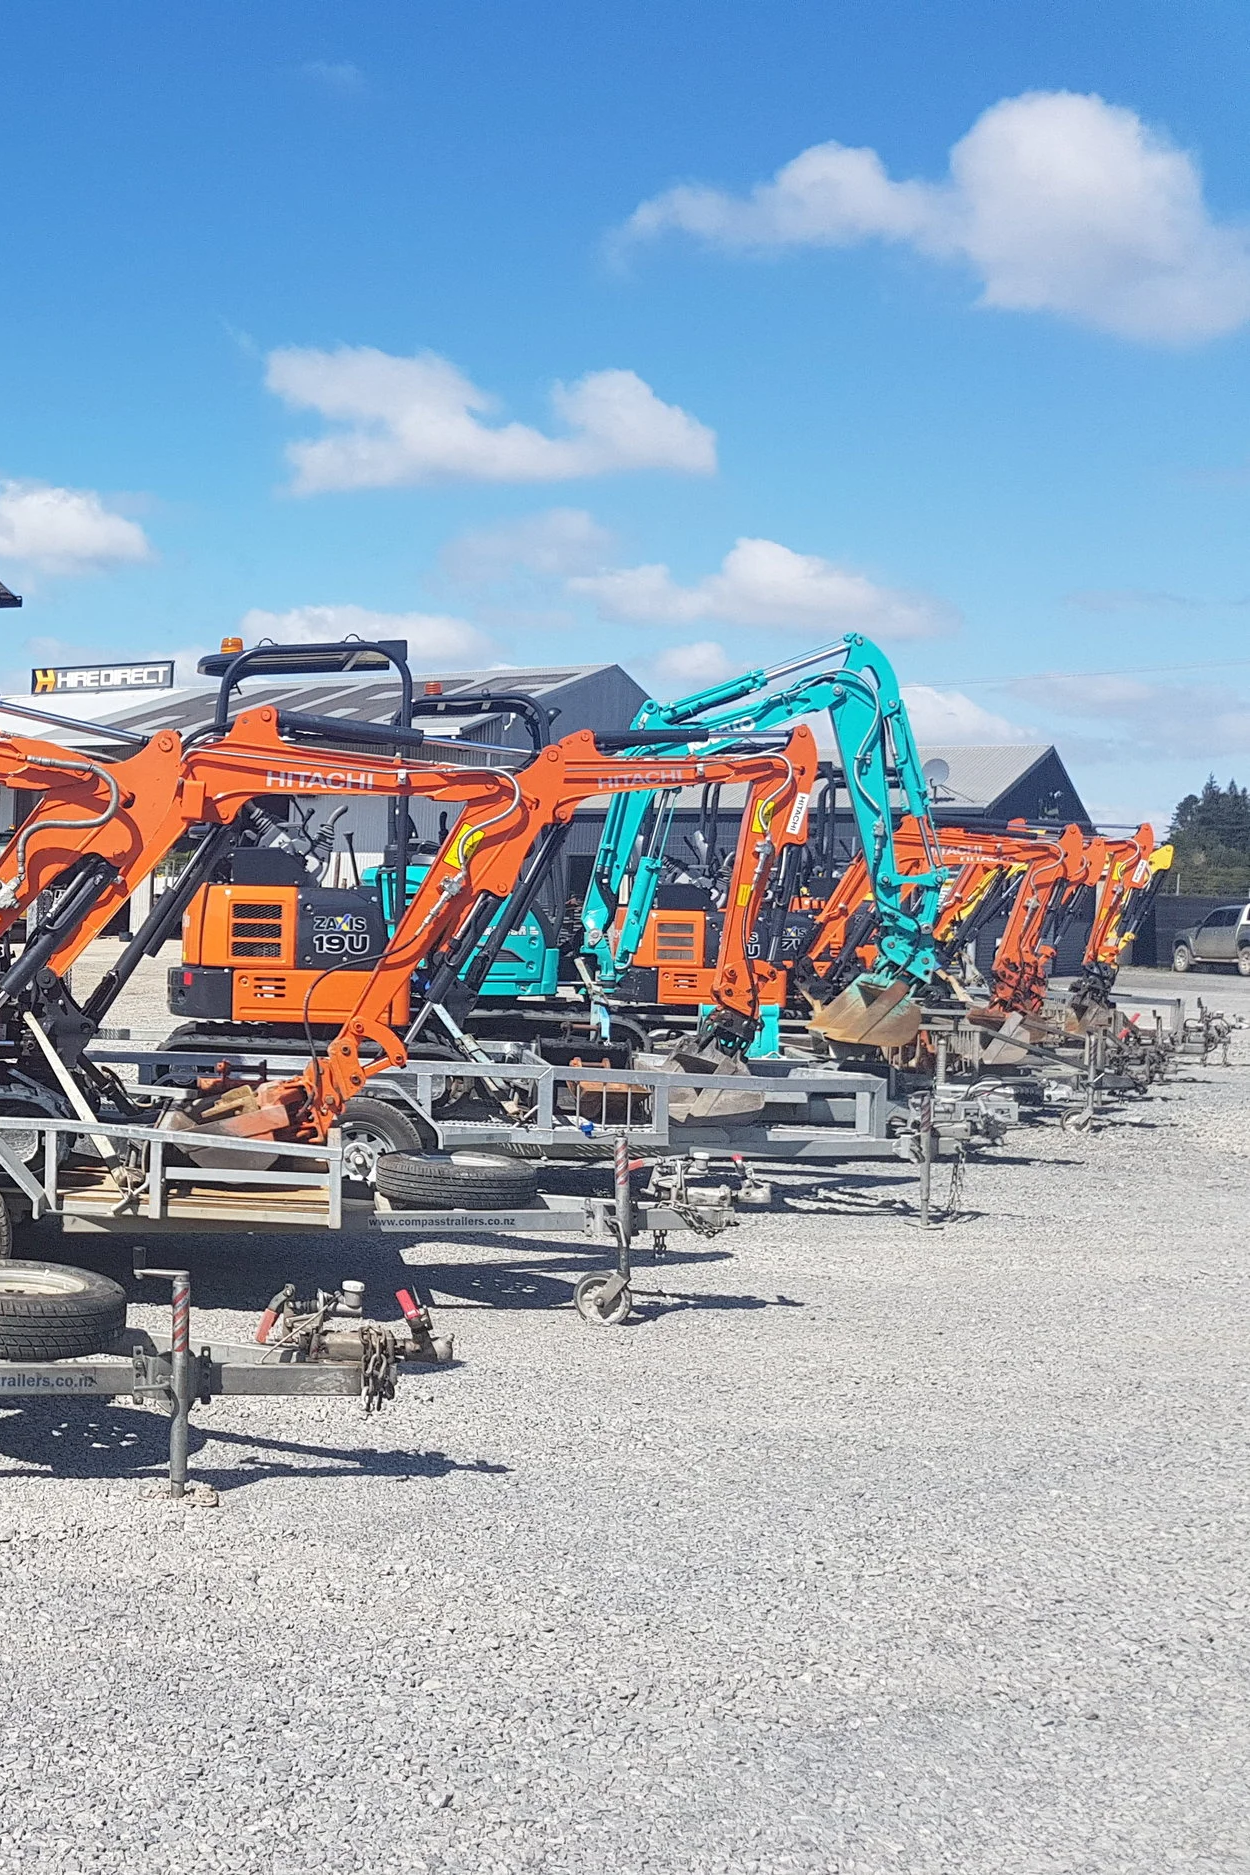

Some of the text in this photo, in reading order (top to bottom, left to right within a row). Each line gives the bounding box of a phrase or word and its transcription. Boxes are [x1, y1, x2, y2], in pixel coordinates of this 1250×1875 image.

[266, 770, 374, 790] HITACHI
[598, 769, 683, 790] HITACHI
[790, 795, 806, 831] HITACHI
[313, 913, 367, 932] ZAXIS
[313, 934, 370, 955] 19U
[369, 1216, 516, 1228] www.compasstrailers.co.nz
